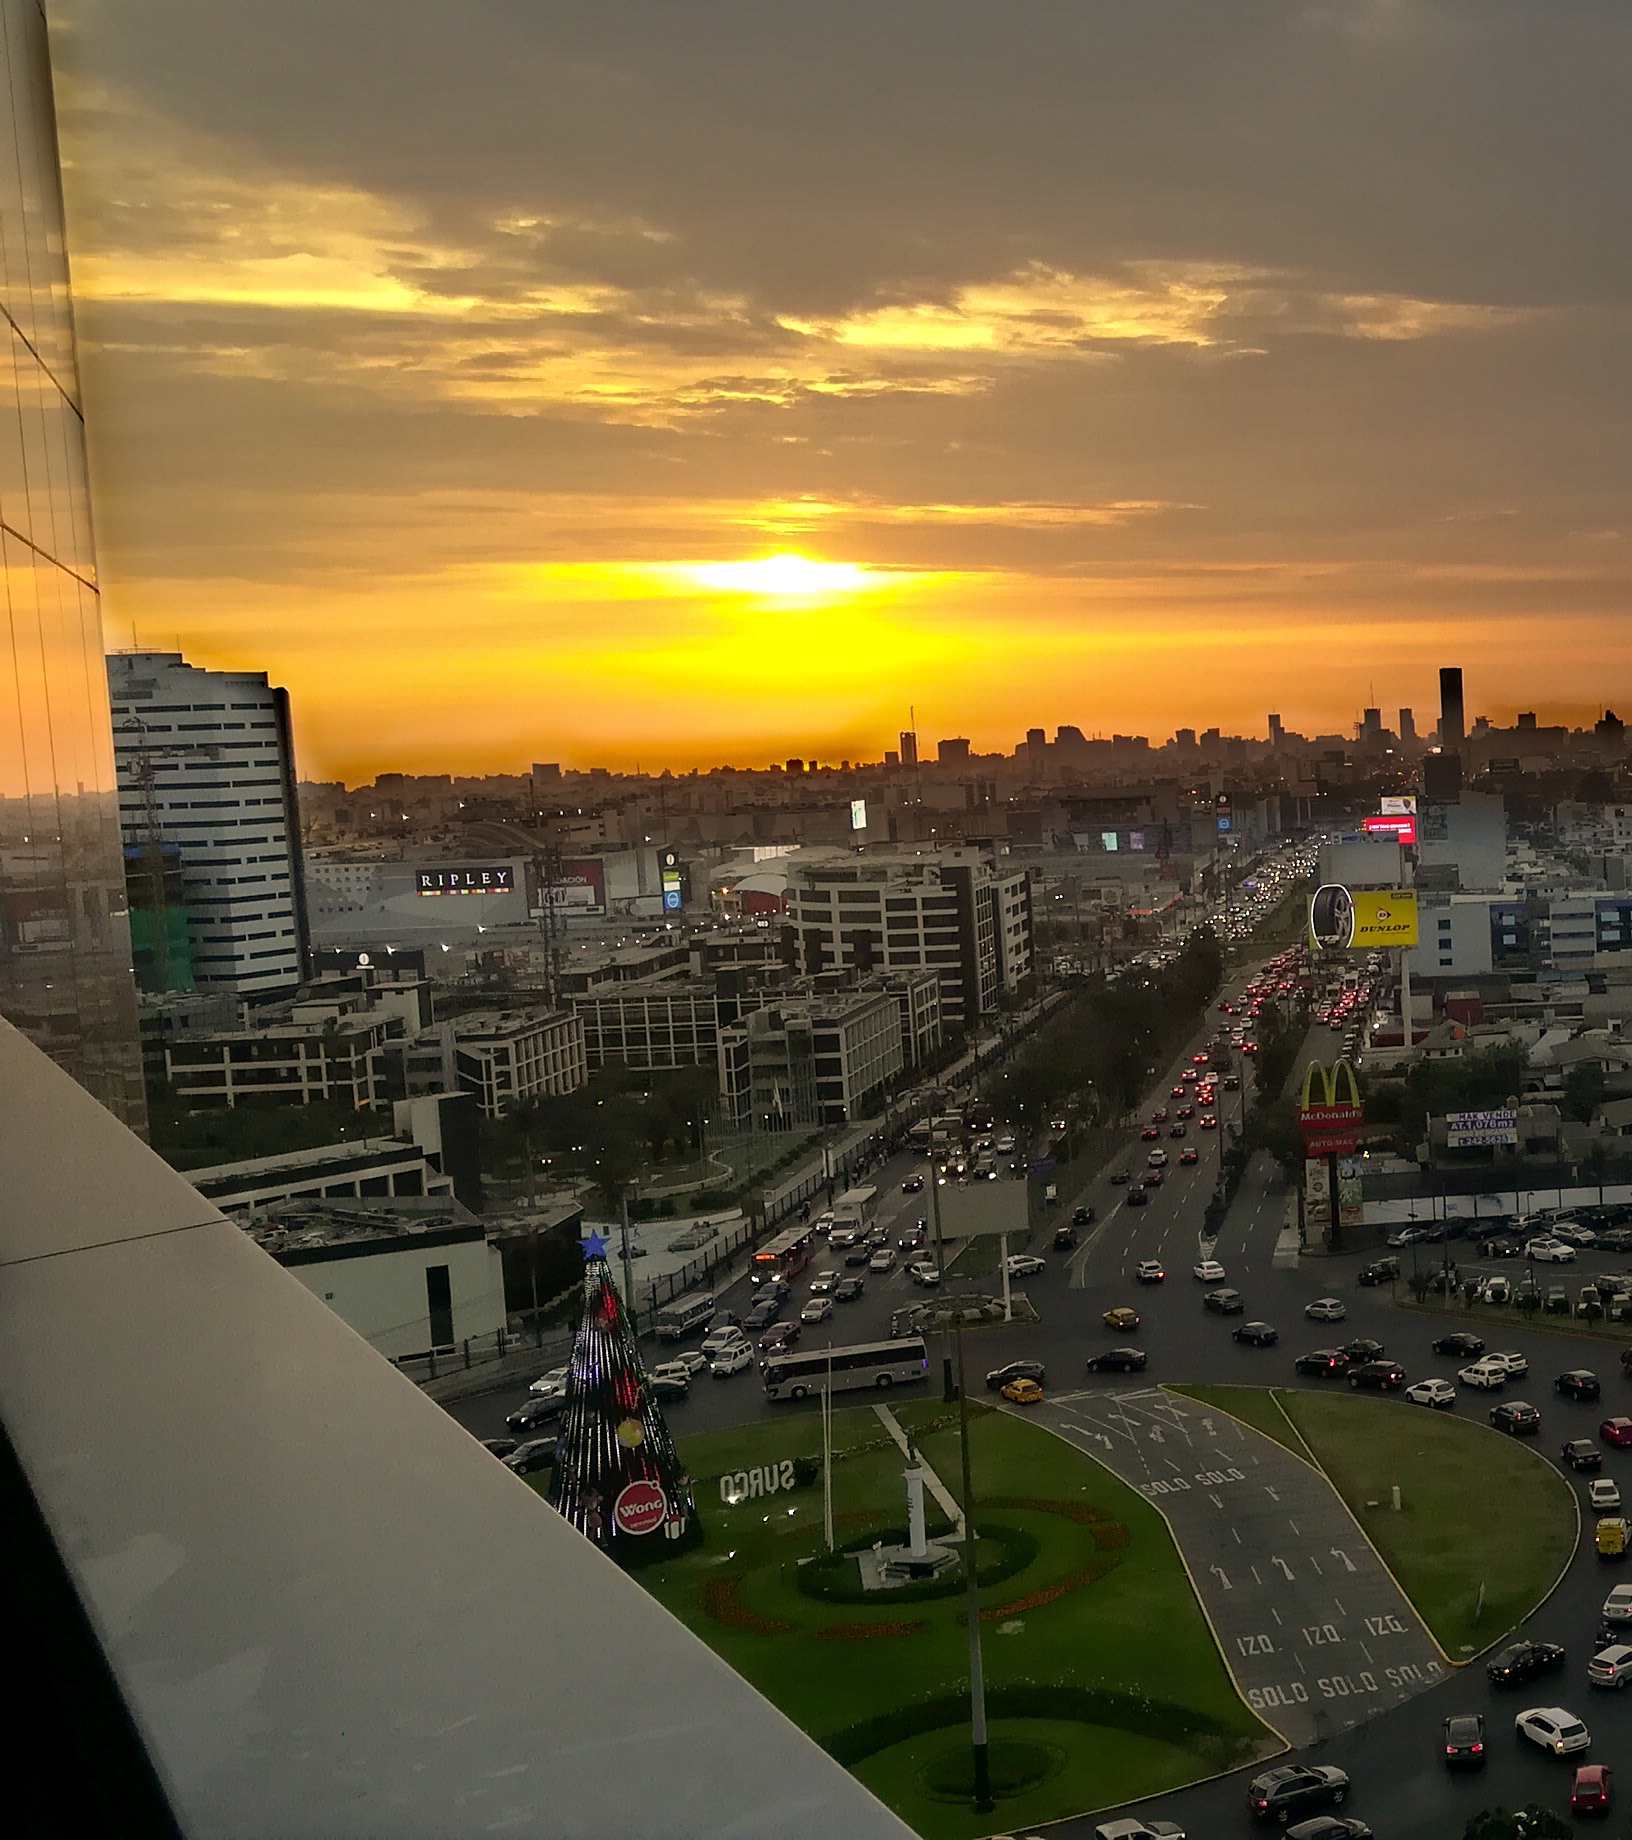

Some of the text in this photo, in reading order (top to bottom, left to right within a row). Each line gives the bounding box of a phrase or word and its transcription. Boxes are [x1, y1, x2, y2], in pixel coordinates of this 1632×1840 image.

[421, 871, 508, 887] RIPLEY
[1360, 924, 1411, 933] DUNLOP
[1300, 1109, 1363, 1121] McDonald's
[1483, 1111, 1516, 1120] VENDE
[1140, 1467, 1246, 1496] SOLO SOLO
[619, 1498, 663, 1518] Wong
[1247, 1682, 1309, 1709] SOLO
[1317, 1671, 1379, 1698] SOLO
